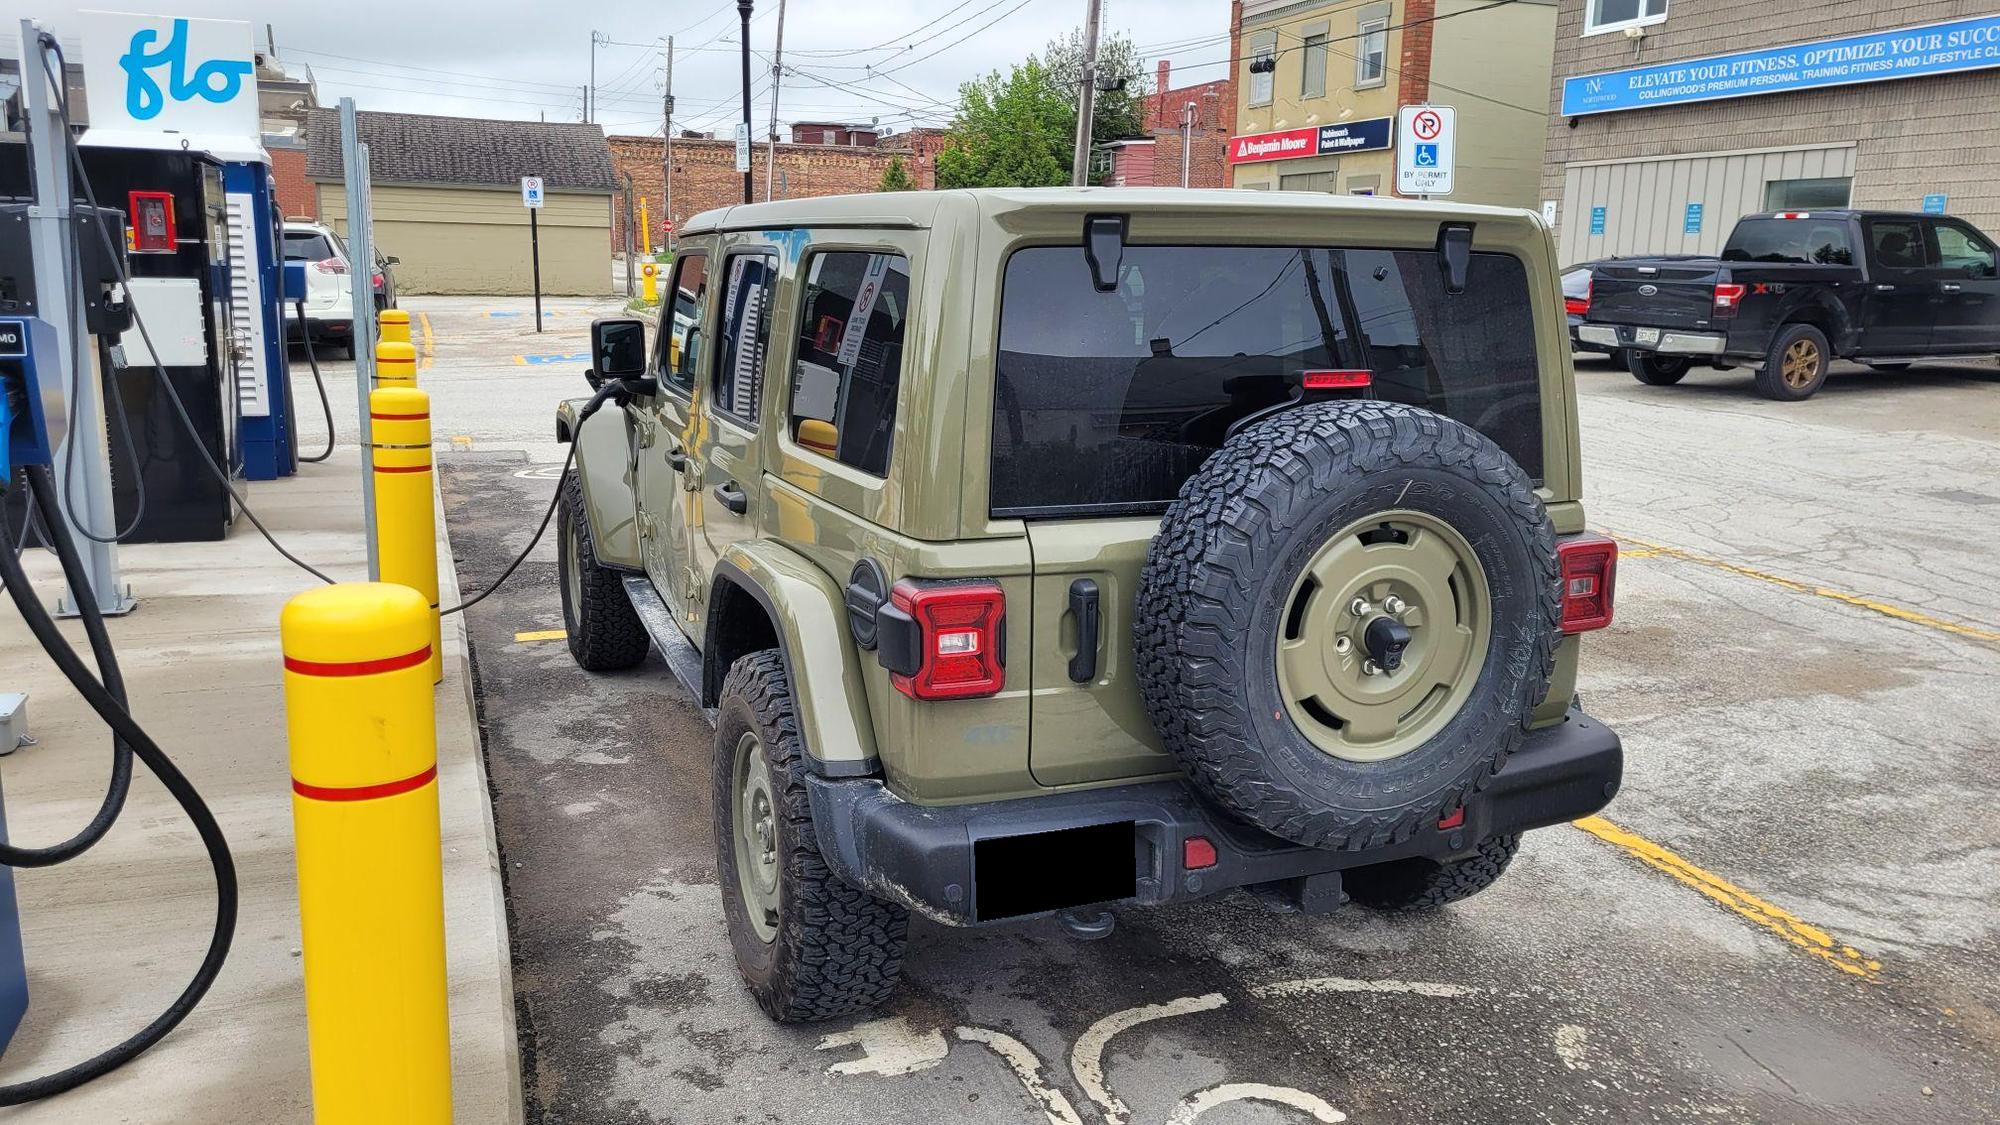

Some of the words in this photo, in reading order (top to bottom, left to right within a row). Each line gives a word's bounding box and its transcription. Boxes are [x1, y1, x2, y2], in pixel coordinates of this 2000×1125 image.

[119, 19, 253, 120] flo
[1628, 70, 1686, 89] ELEVATE
[1690, 64, 1728, 81] YOUR
[1731, 55, 1799, 75] FITNESS.
[1804, 42, 1886, 66] OPTIMIZE
[1890, 34, 1942, 54] YOUR
[1947, 26, 2000, 48] SUCC
[1638, 83, 1705, 100] COLLINGWOOD'S
[1707, 79, 1748, 92] PREMIUM
[1750, 72, 1799, 86] PERSONAL
[1802, 65, 1848, 80] TRAINING
[1851, 59, 1893, 74] FITNESS
[1896, 56, 1920, 68] AND
[1922, 48, 1982, 65] LIFESTYLE
[1985, 46, 2000, 57] CL
[1247, 139, 1280, 156] Benjamin
[1281, 138, 1306, 150] Moore
